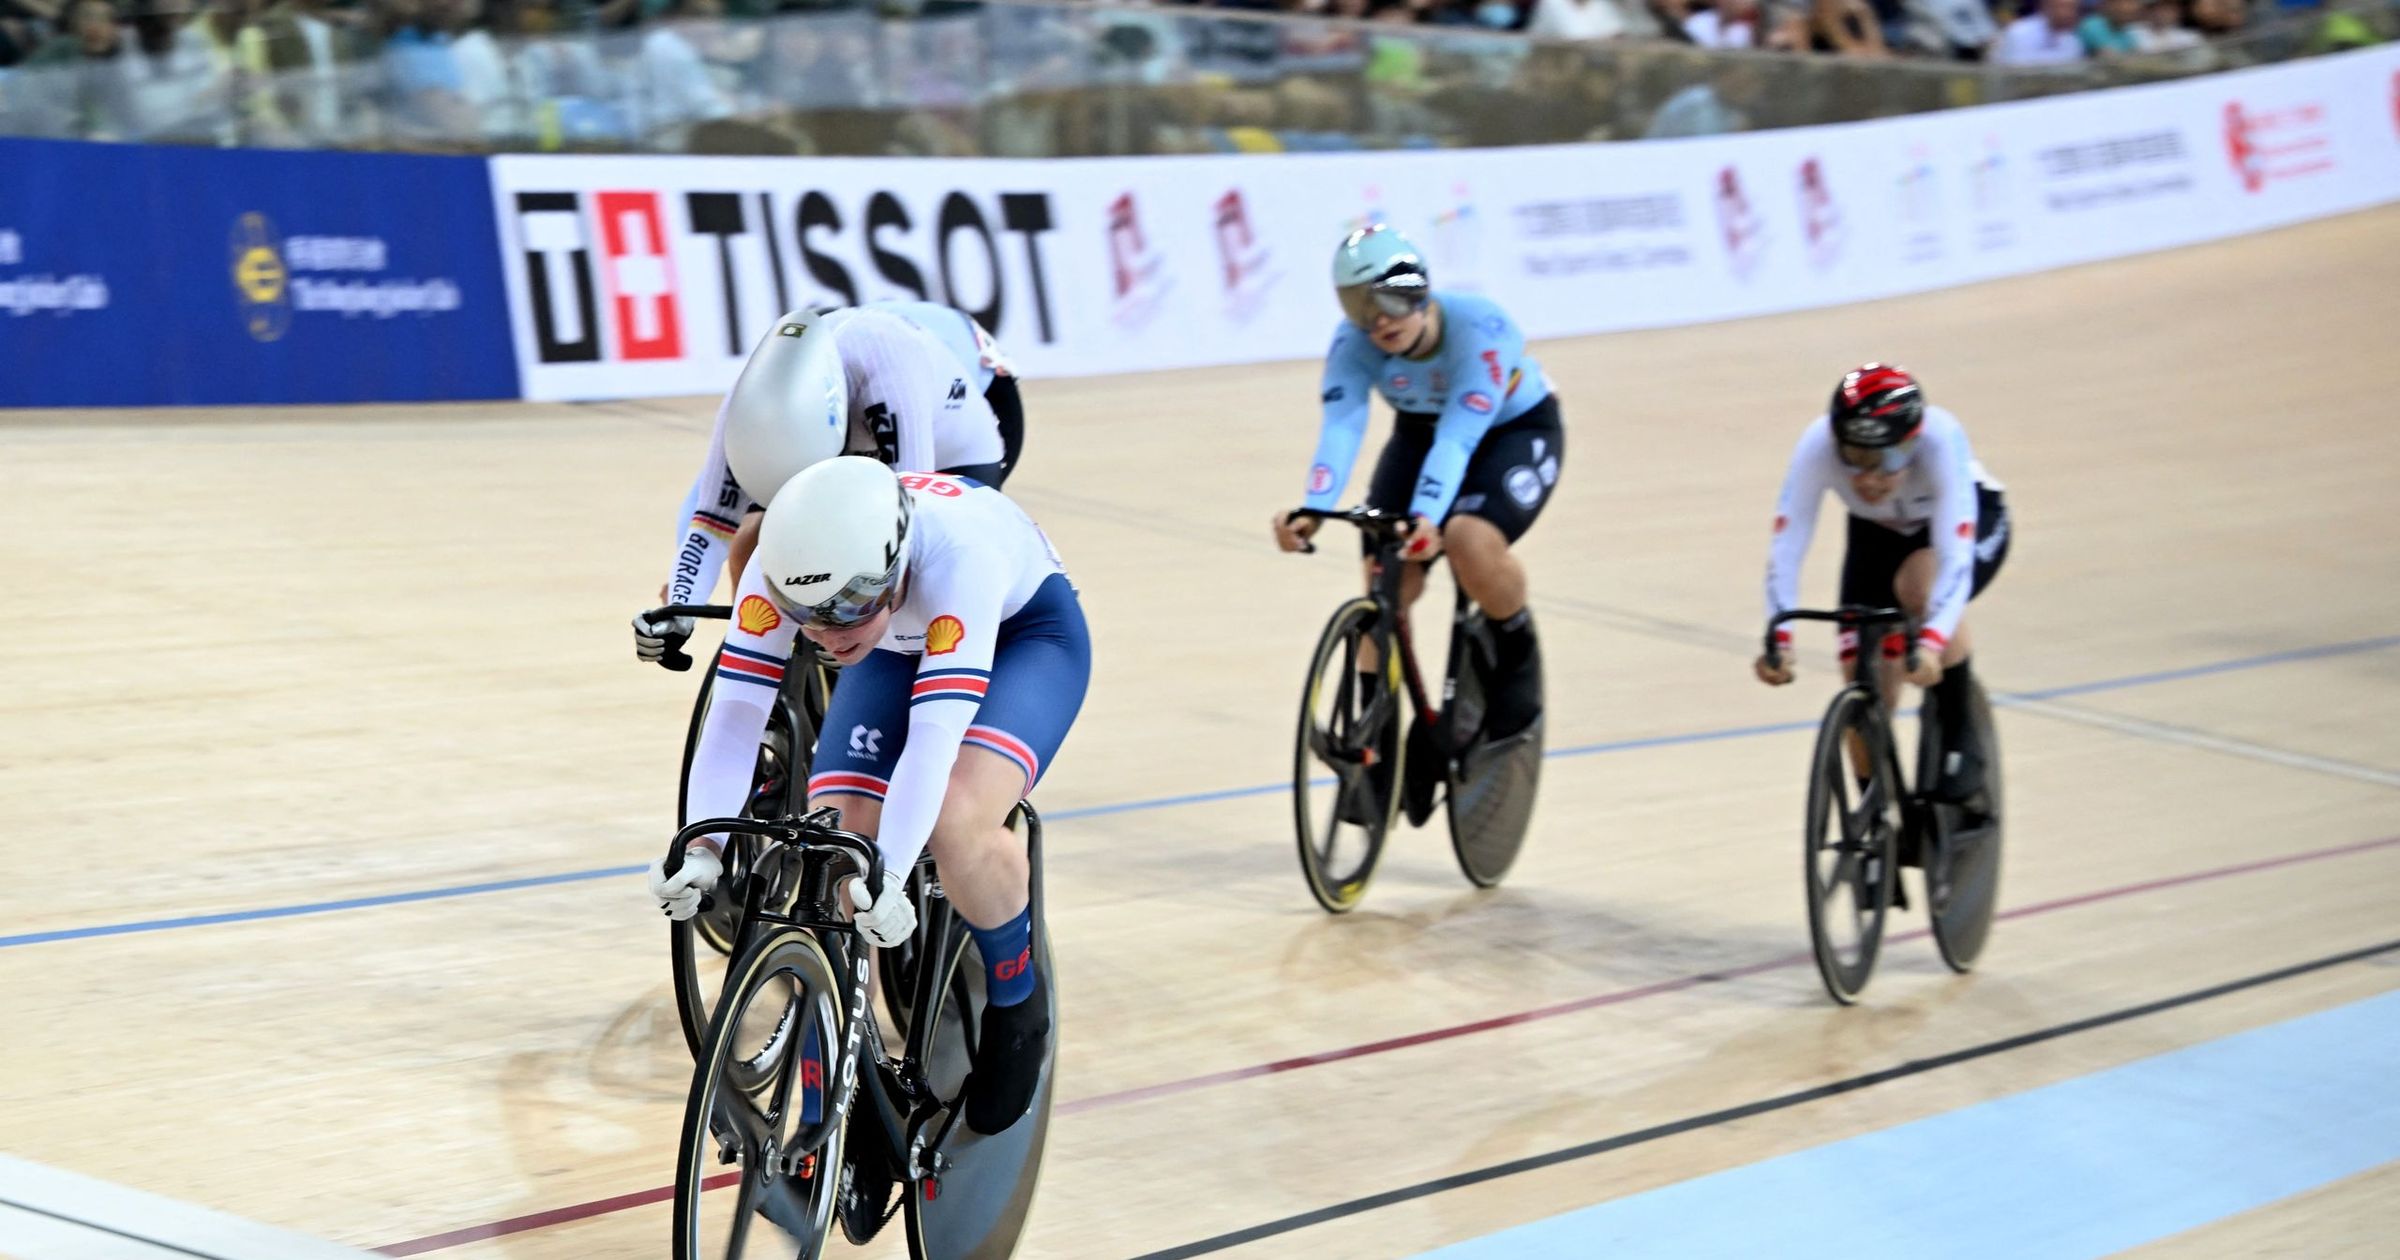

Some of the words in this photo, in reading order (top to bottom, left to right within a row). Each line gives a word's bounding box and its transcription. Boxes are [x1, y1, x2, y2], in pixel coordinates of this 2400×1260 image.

[684, 190, 1055, 357] TISSOT
[784, 572, 833, 586] LAZER
[835, 957, 871, 1115] LOTUS
